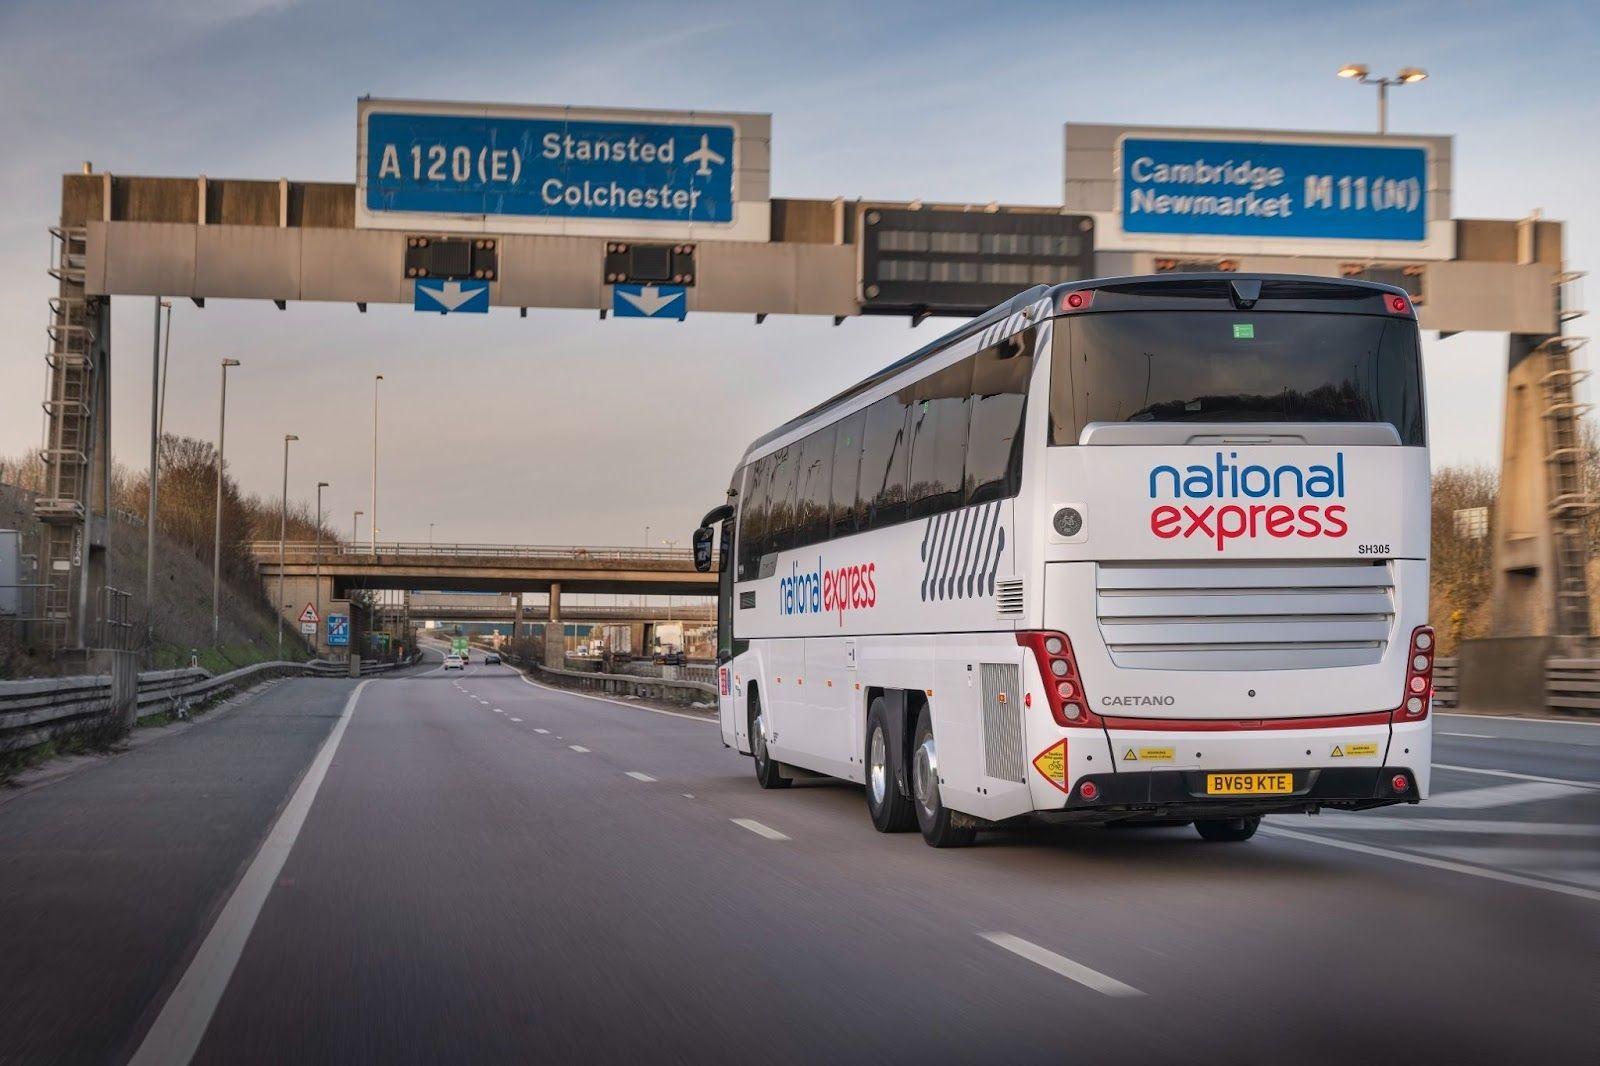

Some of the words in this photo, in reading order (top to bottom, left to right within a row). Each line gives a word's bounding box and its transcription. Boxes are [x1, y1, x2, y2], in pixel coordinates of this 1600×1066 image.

[542, 132, 675, 163] Stansted
[1131, 156, 1285, 190] Cambridge
[541, 178, 701, 209] Colchester
[1130, 187, 1293, 218] Newmarket
[1149, 452, 1345, 498] national
[1150, 504, 1348, 551] express
[1358, 544, 1390, 554] SH305
[780, 555, 822, 615] national
[823, 562, 876, 628] express
[1101, 696, 1175, 706] CAETANO
[1214, 776, 1253, 791] BV69
[1257, 776, 1286, 790] KTE
